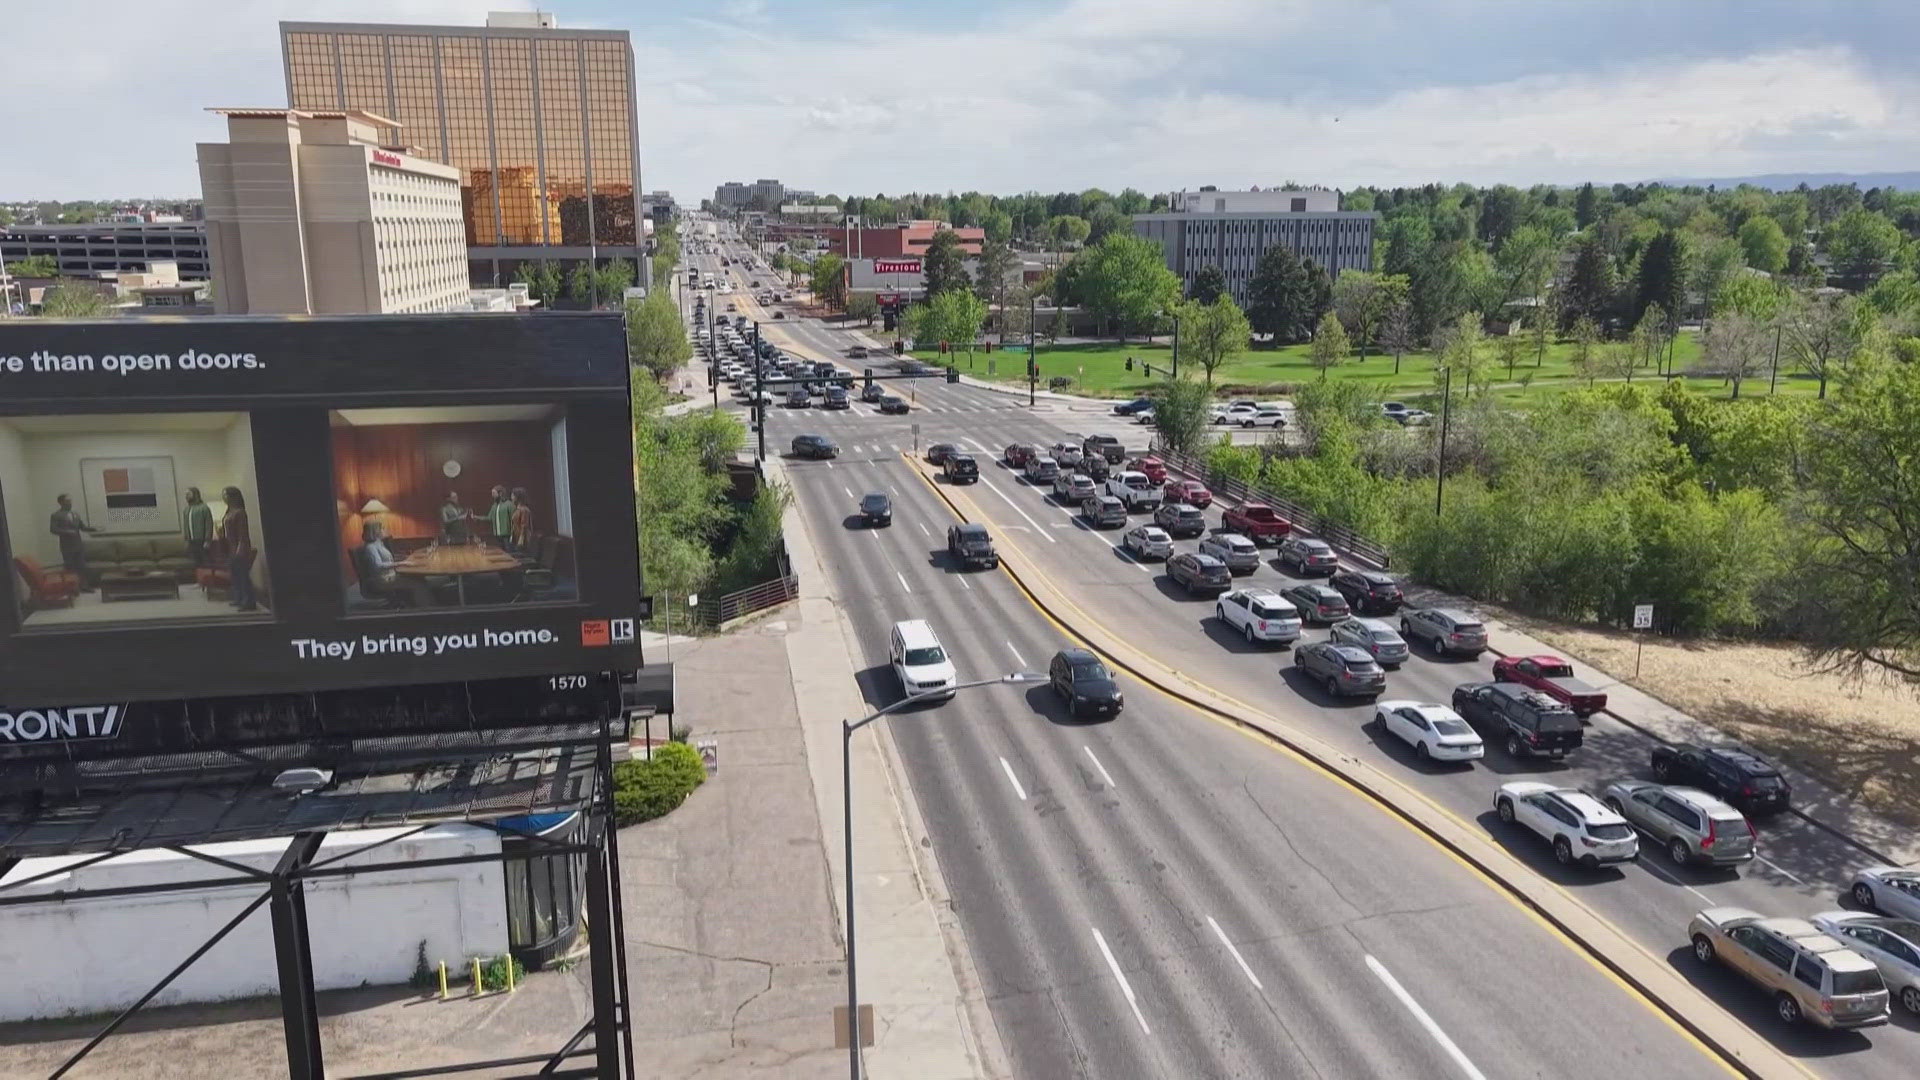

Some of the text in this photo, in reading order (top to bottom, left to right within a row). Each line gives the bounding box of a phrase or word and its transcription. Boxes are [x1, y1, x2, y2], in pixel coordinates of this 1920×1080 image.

[30, 350, 94, 372] than
[101, 353, 171, 376] open
[178, 348, 266, 369] doors.
[1636, 616, 1650, 626] 35
[291, 628, 559, 661] They bring you home.
[548, 674, 588, 690] 1570
